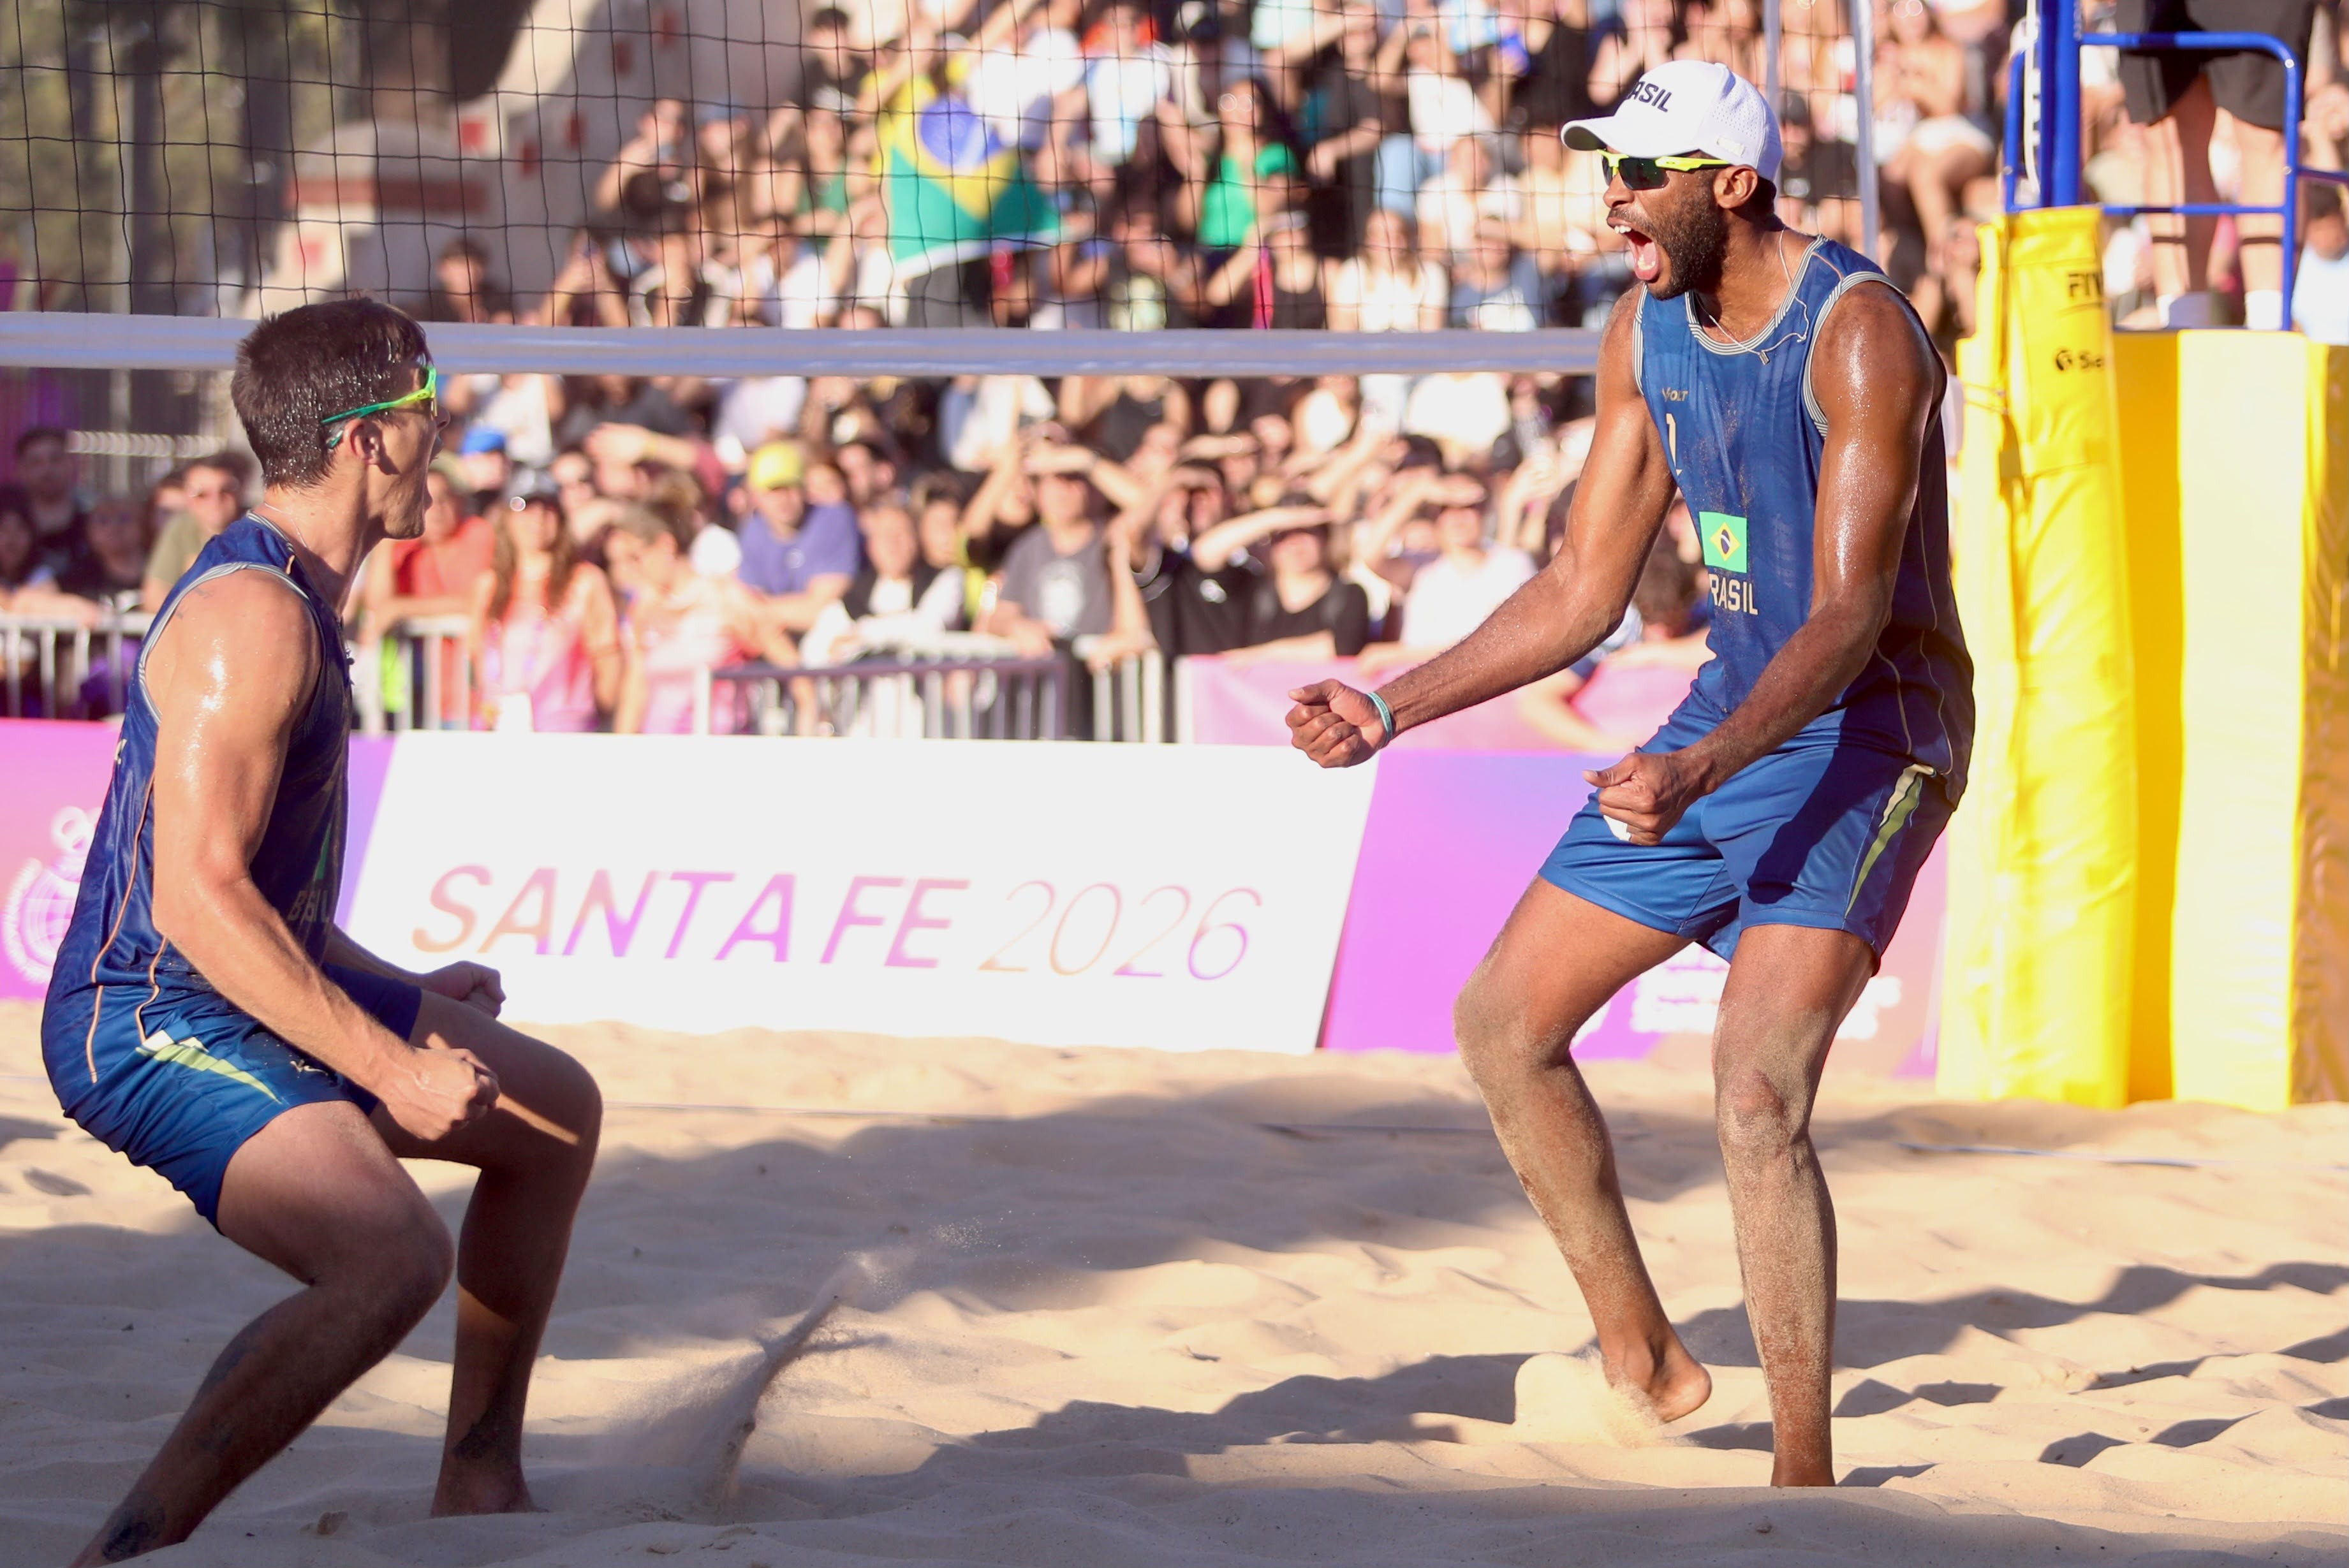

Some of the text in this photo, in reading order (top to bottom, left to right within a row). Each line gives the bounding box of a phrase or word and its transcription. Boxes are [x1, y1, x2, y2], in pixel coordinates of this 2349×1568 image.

[1661, 386, 1689, 403] VOLT
[409, 863, 1263, 981] SANTA FE 2026
